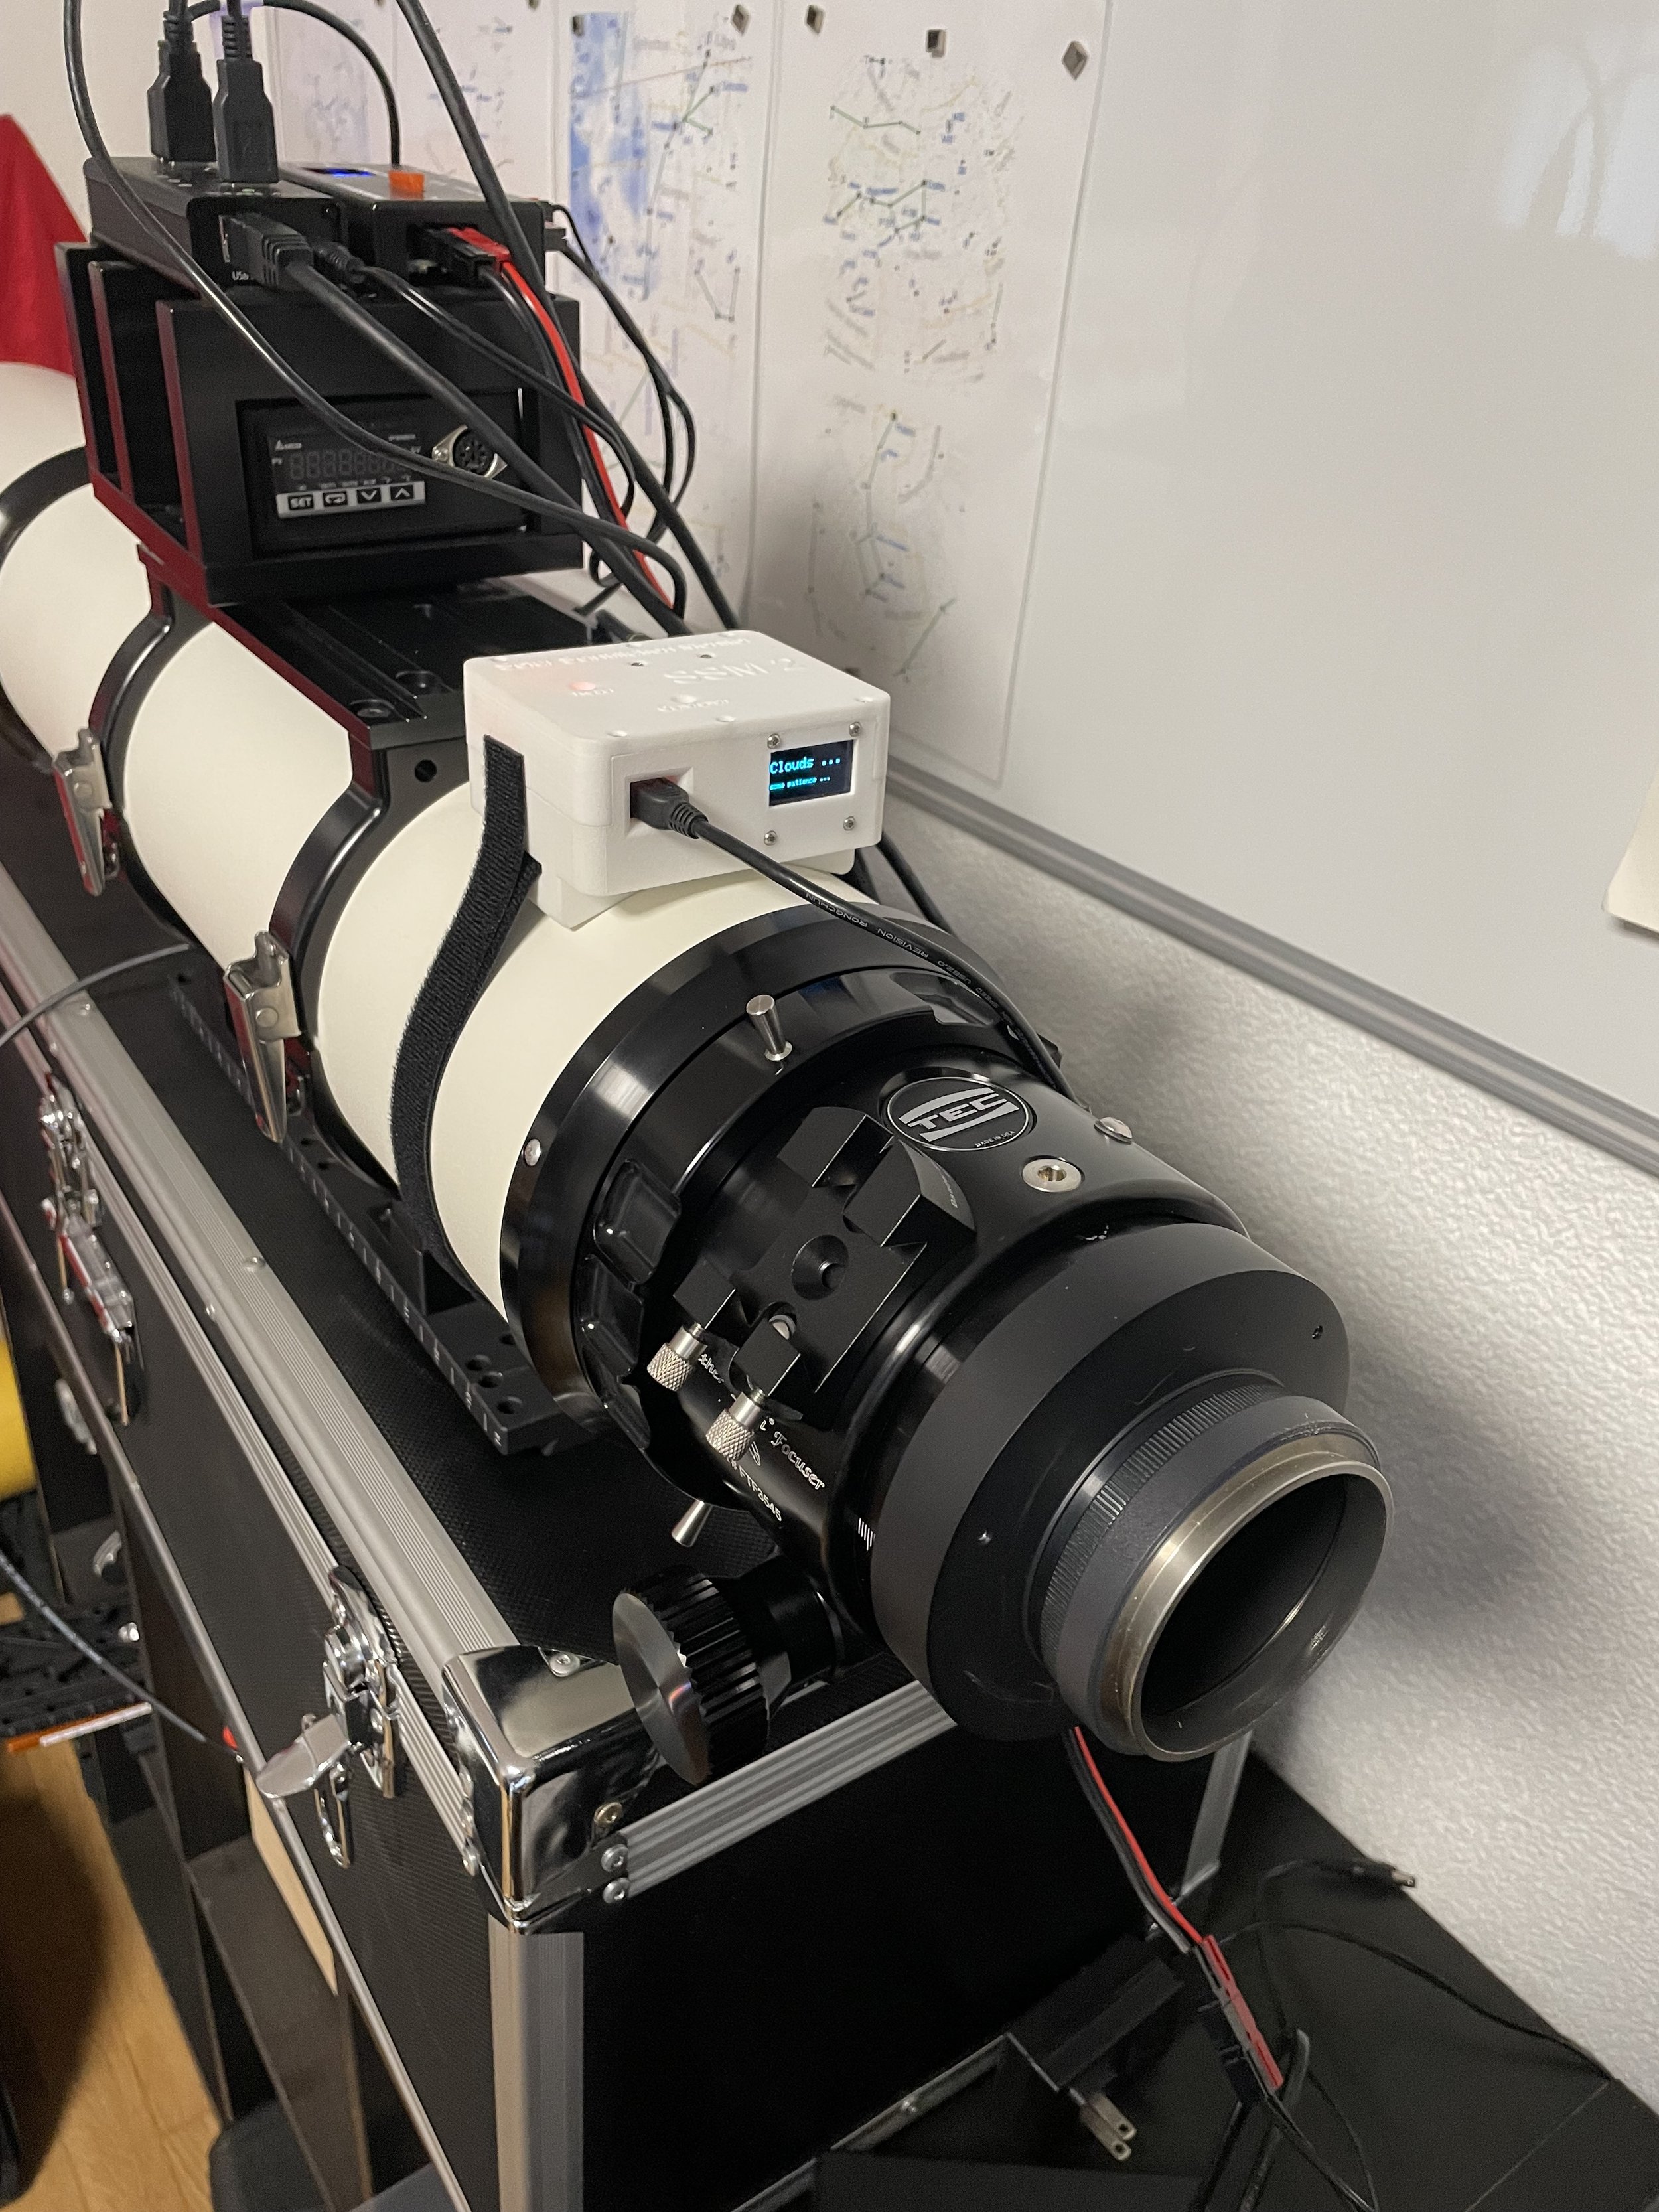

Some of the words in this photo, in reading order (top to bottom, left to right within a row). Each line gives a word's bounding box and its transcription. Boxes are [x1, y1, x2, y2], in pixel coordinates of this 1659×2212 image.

[770, 756, 814, 774] Clouds
[806, 892, 868, 928] RONGCHUN
[877, 928, 929, 958] REVISION
[907, 1092, 1008, 1130] TEC
[974, 1138, 994, 1147] MADE
[770, 1430, 825, 1490] Focuser
